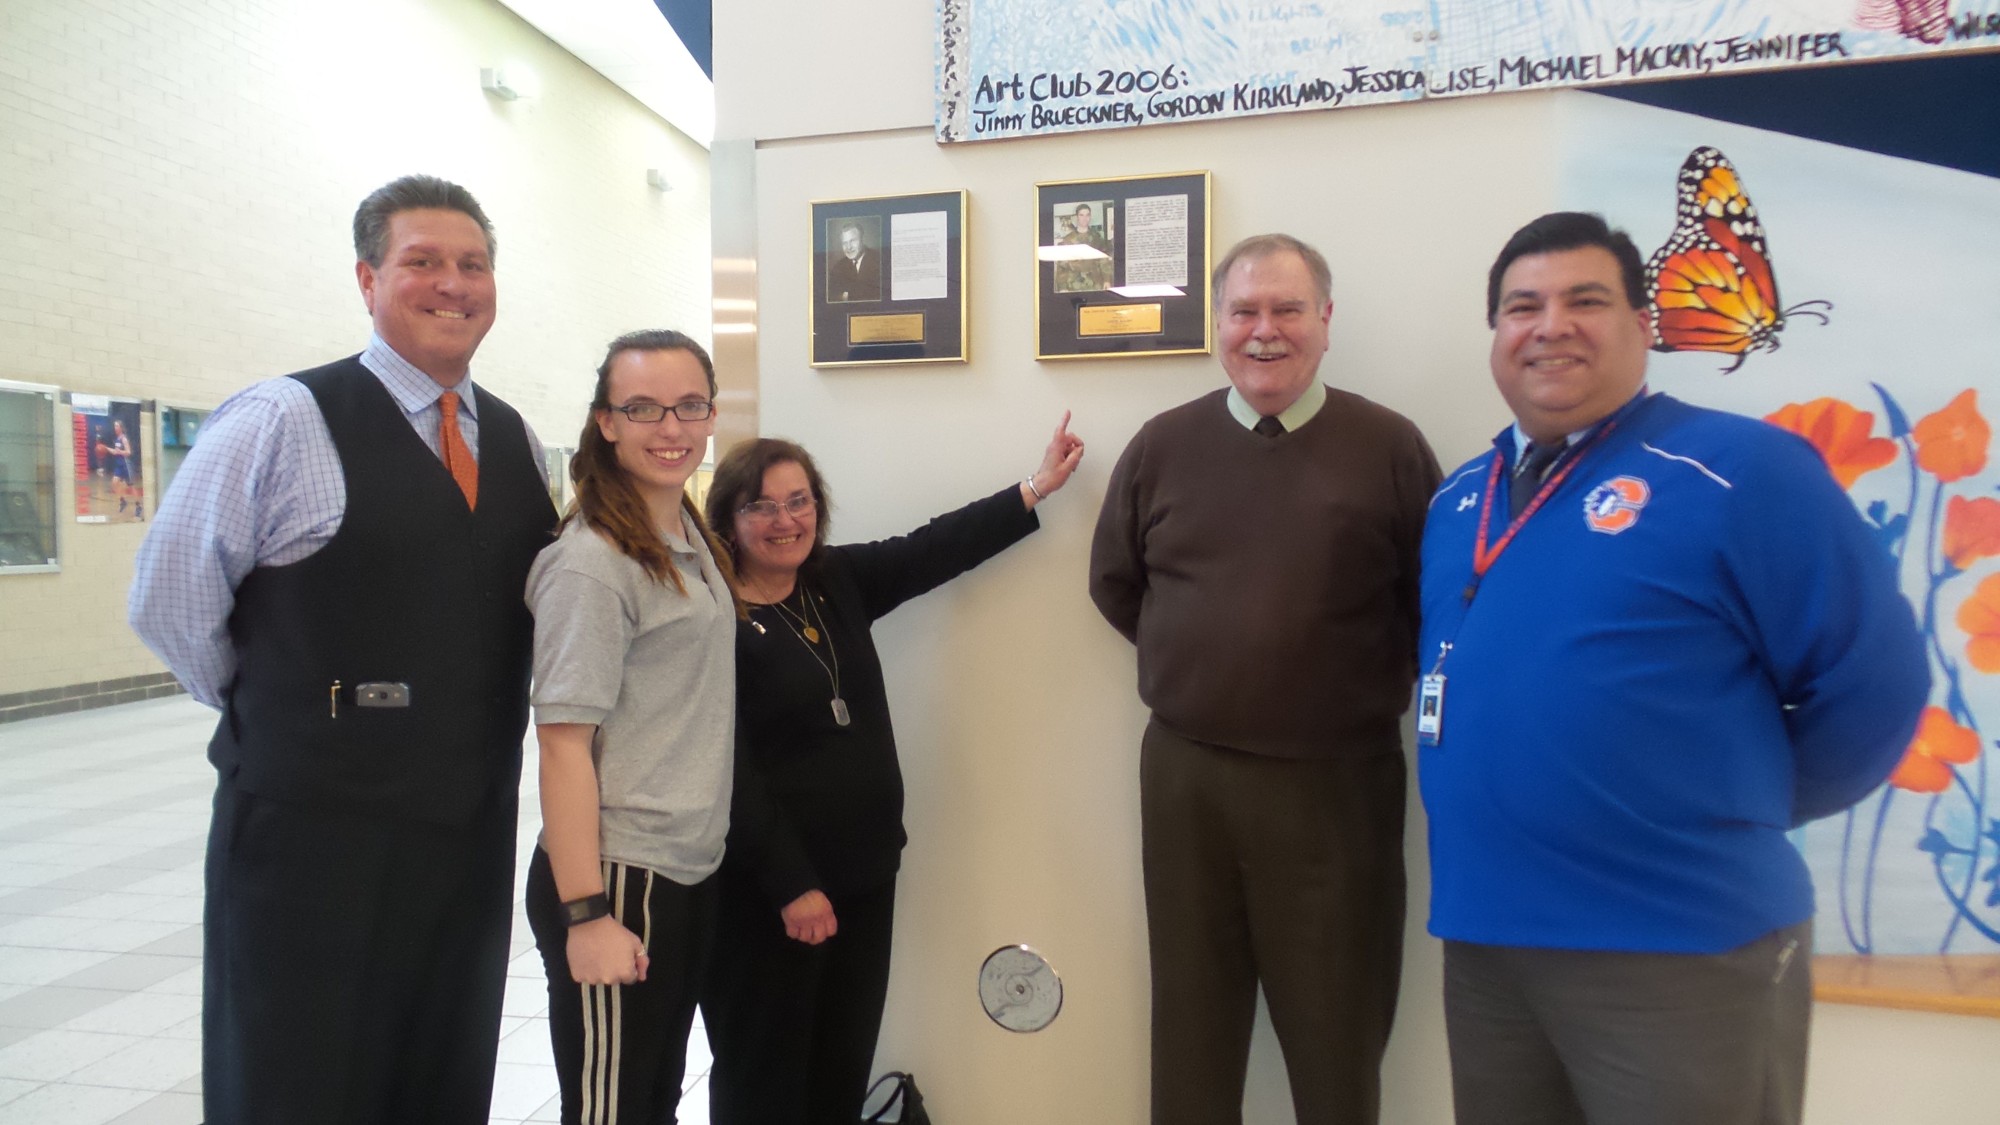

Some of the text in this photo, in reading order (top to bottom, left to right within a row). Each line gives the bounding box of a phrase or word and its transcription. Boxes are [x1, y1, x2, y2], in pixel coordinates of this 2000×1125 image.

[975, 64, 1189, 104] Art Club 2006:
[1031, 102, 1144, 129] BRUECKNER,
[1148, 91, 1225, 118] GORDON
[1233, 77, 1343, 111] KIRKLAND,
[1341, 65, 1426, 94] JESSICA
[1499, 56, 1613, 87] MICHAEL
[1714, 32, 1850, 64] JENNIFER
